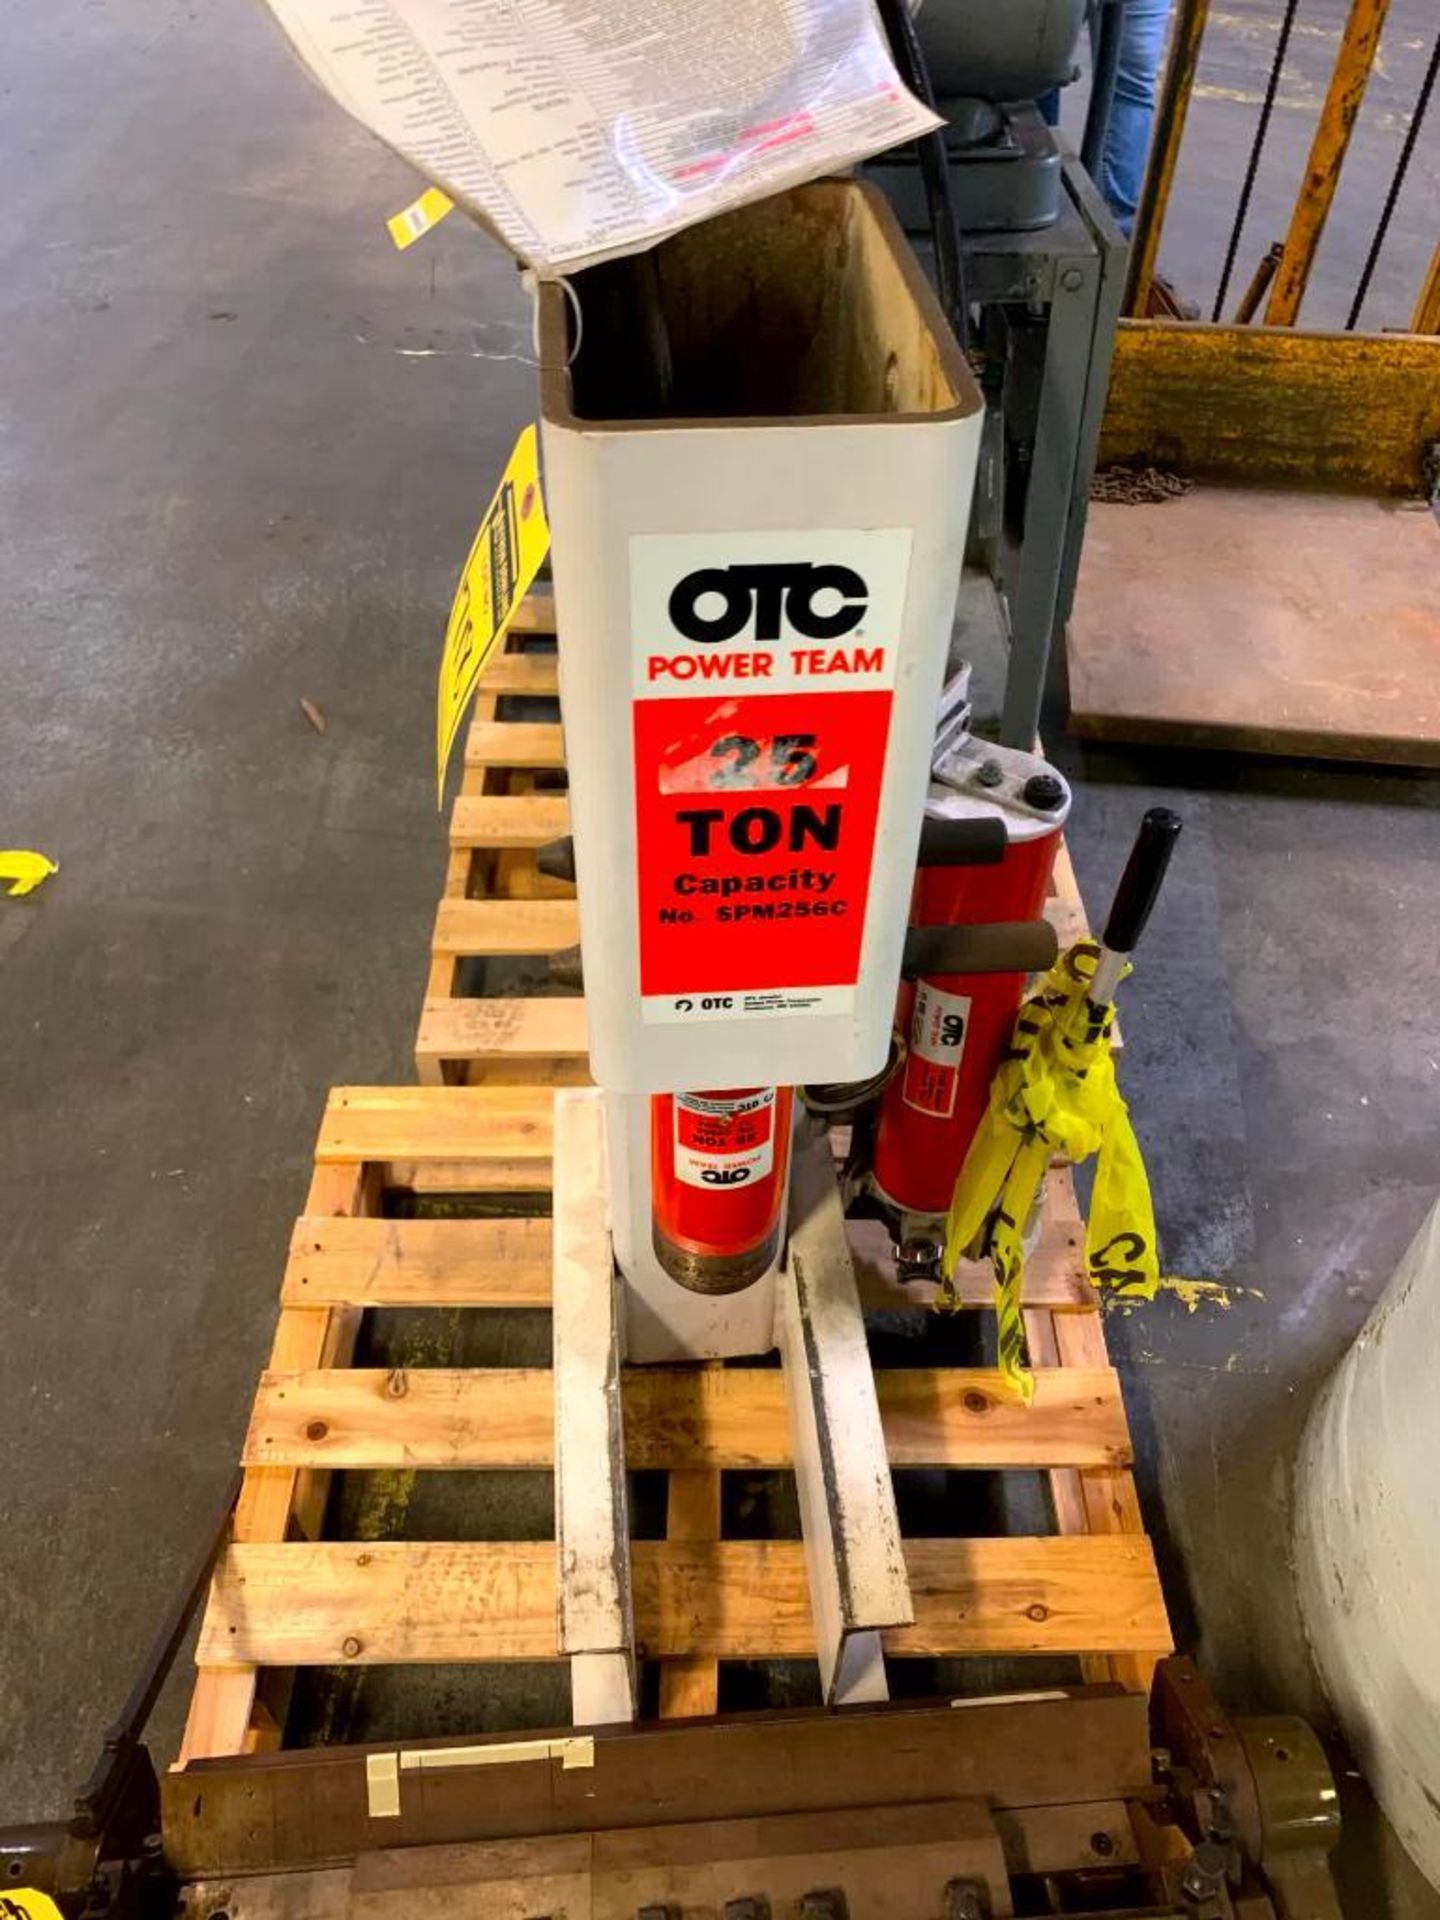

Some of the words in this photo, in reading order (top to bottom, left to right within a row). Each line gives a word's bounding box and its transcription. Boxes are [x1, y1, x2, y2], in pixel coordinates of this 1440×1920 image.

[668, 562, 869, 643] OTC
[648, 652, 773, 681] POWER
[790, 648, 885, 675] TEAM
[709, 734, 818, 789] 25
[675, 803, 843, 857] TON
[674, 869, 837, 898] Capacity
[716, 899, 848, 922] SPM256C
[702, 997, 733, 1010] OTC
[942, 1014, 964, 1047] OTC
[702, 1168, 750, 1184] OTC
